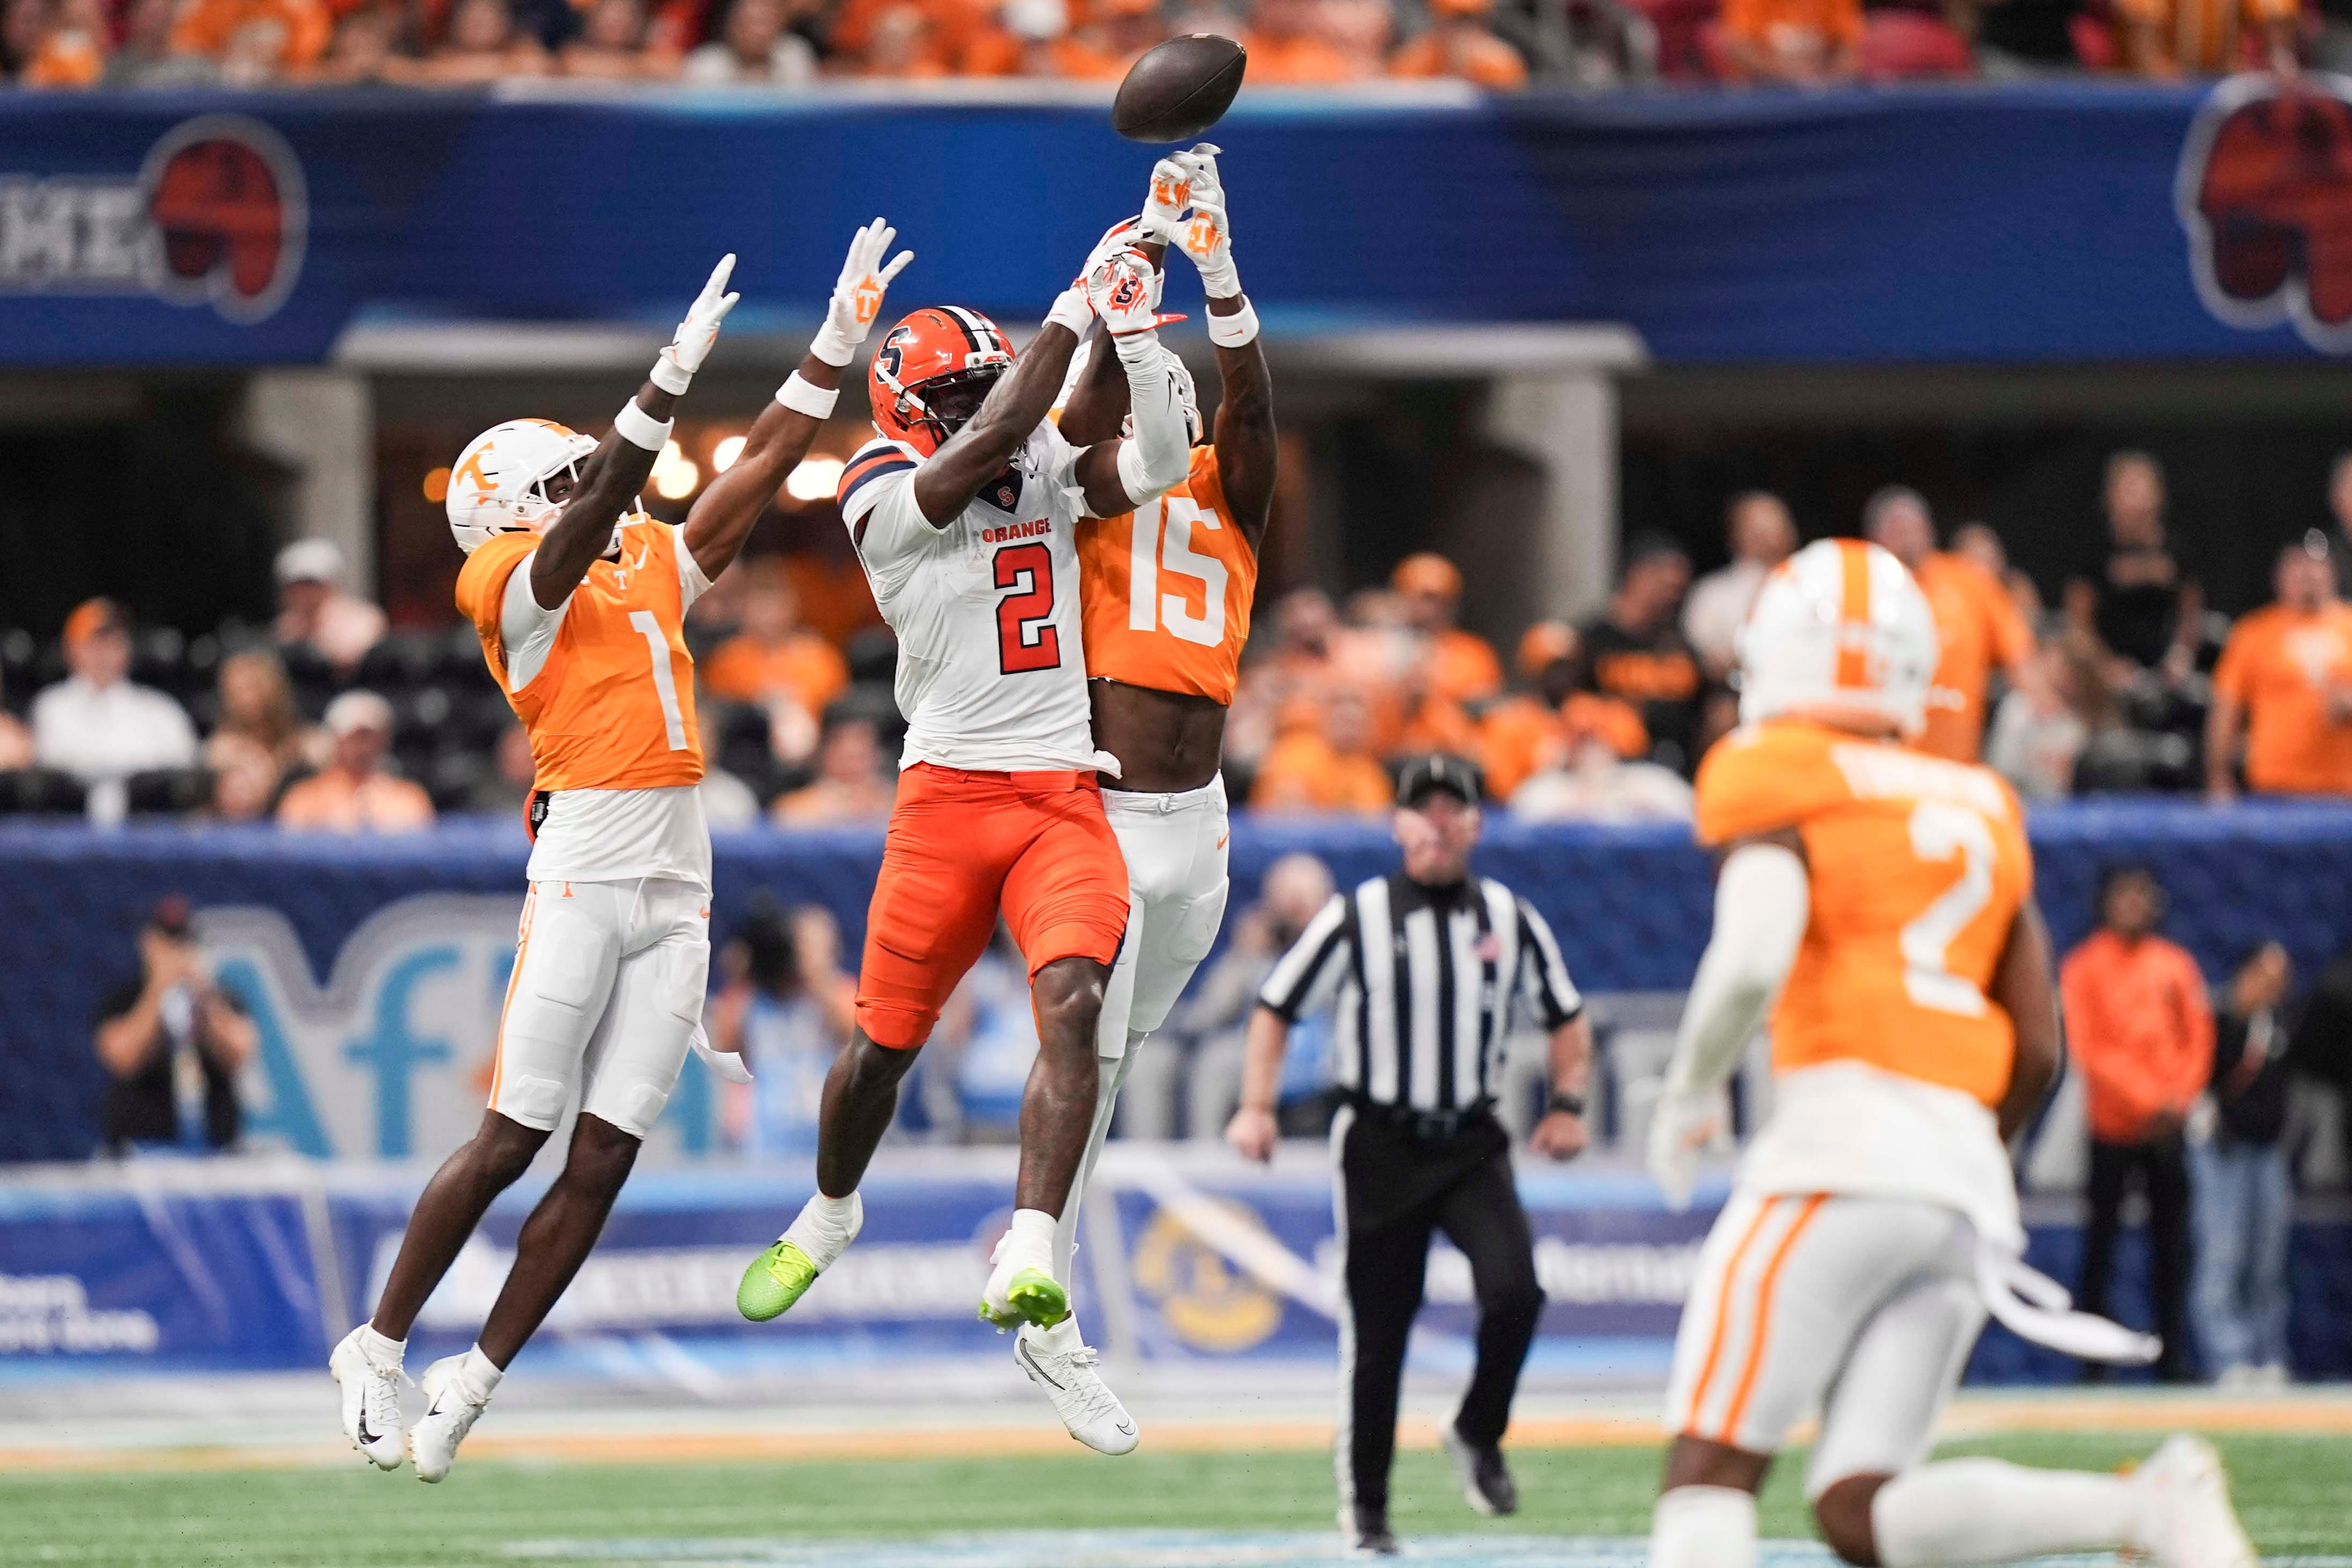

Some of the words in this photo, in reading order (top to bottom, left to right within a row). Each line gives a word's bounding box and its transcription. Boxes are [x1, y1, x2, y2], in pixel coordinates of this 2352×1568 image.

[858, 288, 879, 318] T
[1116, 279, 1137, 303] S
[875, 326, 911, 385] S
[455, 441, 500, 506] T
[997, 486, 1015, 507] S
[982, 517, 1052, 543] ORANGE
[613, 570, 627, 590] T
[1129, 495, 1229, 648] 15
[992, 541, 1061, 675] 2
[628, 610, 688, 751] 1
[1900, 802, 1999, 1019] 2
